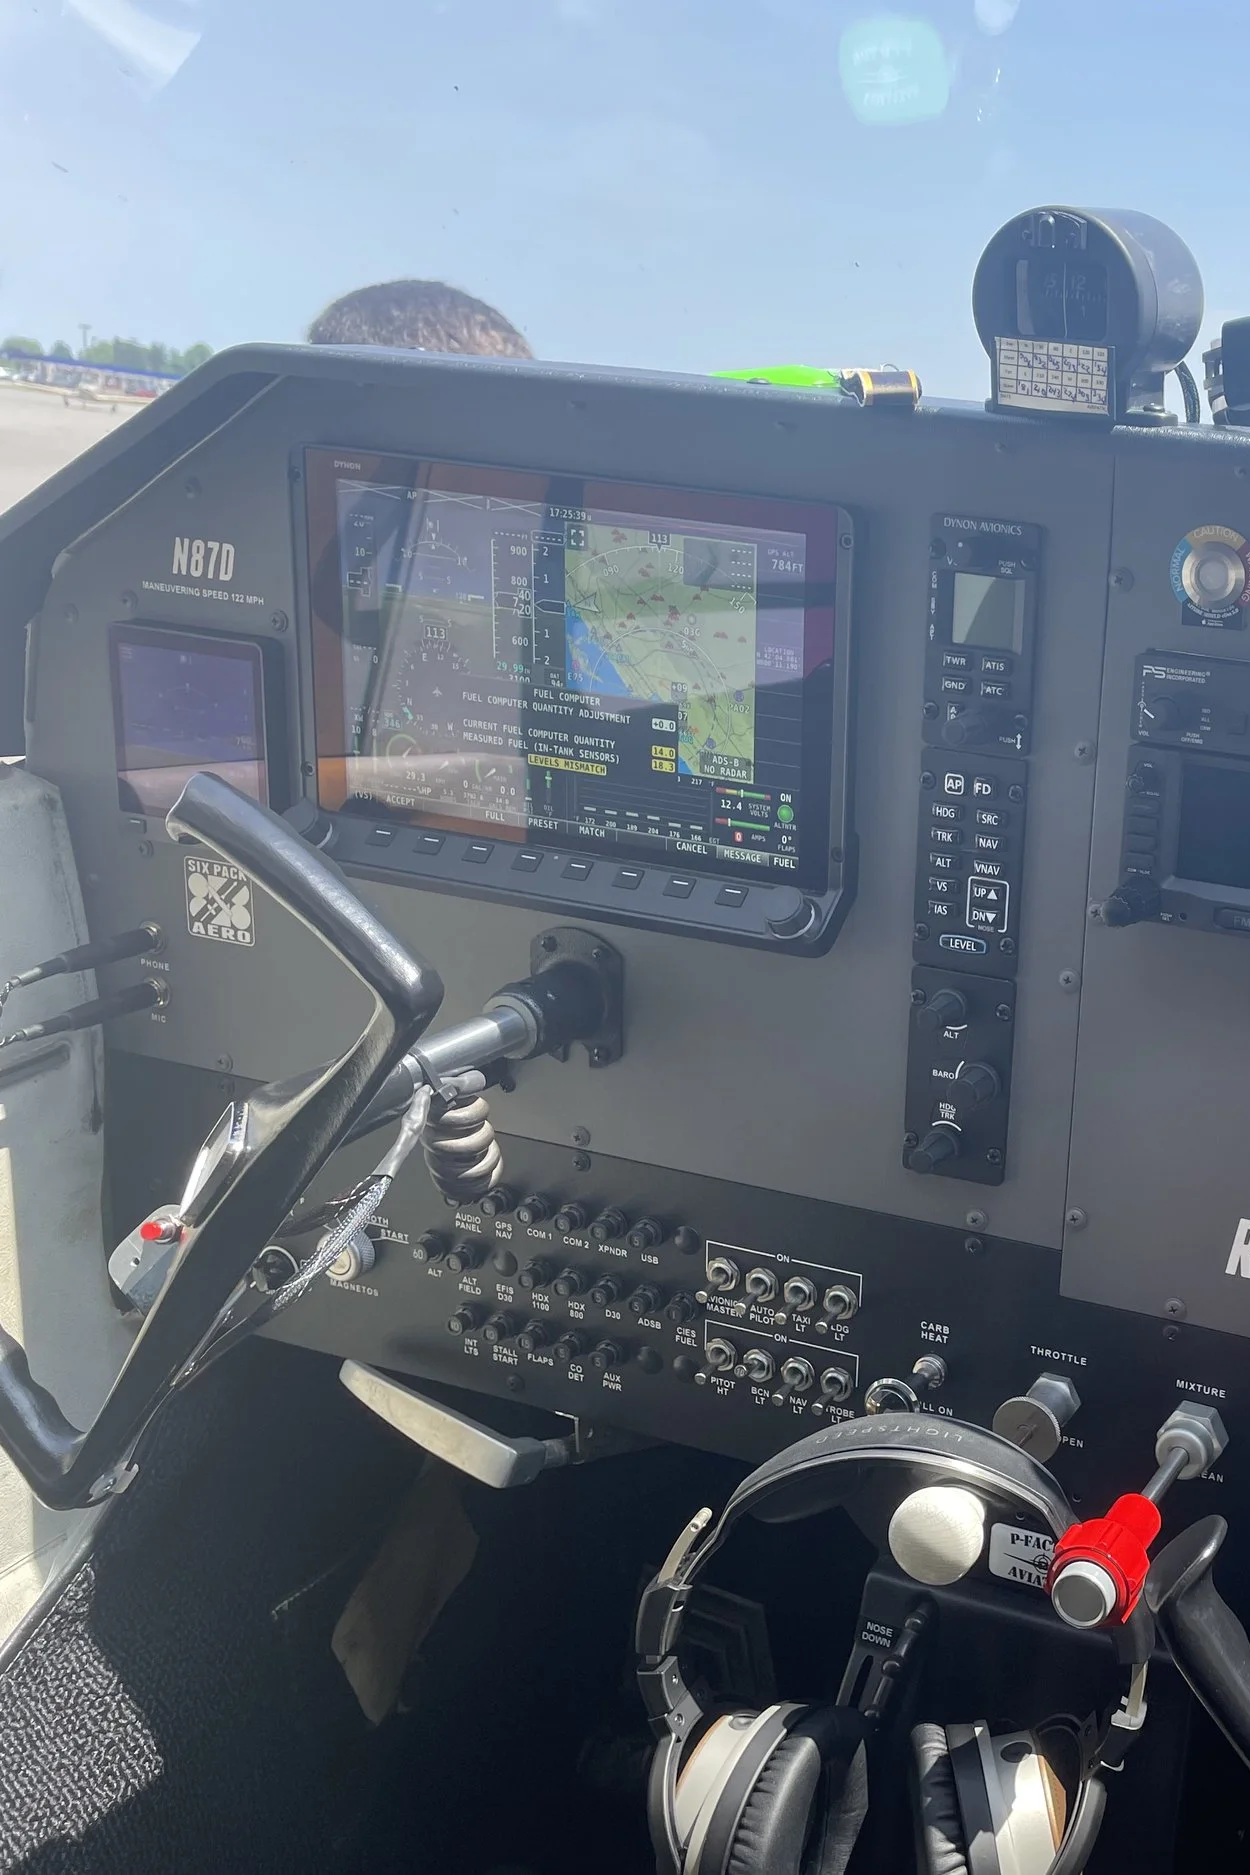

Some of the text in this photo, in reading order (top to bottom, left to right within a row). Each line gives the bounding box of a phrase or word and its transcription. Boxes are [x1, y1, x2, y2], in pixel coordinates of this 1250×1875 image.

[944, 518, 1022, 536] DYNON AVIONICS
[1192, 526, 1240, 542] CAUTION
[172, 537, 235, 581] N87D
[1173, 547, 1186, 592] NORMAL
[142, 581, 265, 605] MANEUVERING SPEED 122 MPH
[946, 656, 966, 666] TWR
[985, 661, 1005, 671] ATIS
[945, 681, 965, 690] GND
[985, 686, 1003, 696] ATC
[462, 692, 631, 724] FUEL COMPUTER QUANTITY ADJUSTMENT
[529, 754, 606, 775] LEVELS MISMATCH
[712, 756, 739, 767] ADS-B
[704, 765, 747, 778] NO RADAR
[947, 779, 962, 789] AP
[976, 783, 991, 795] FD
[936, 807, 955, 818] HDG
[981, 814, 998, 825] SRC
[937, 831, 952, 842] TRK
[979, 838, 998, 849] NAV
[935, 857, 951, 868] ALT
[188, 860, 247, 881] SIX PACK
[975, 863, 1000, 875] VNAV
[936, 881, 948, 892] VS
[974, 887, 987, 898] UP
[934, 904, 948, 915] IAS
[973, 911, 986, 922] DN
[192, 921, 251, 943] AERO
[950, 938, 977, 951] LEVEL
[141, 959, 170, 971] PHONE
[151, 1013, 166, 1023] MIC
[943, 1030, 959, 1039] ALT
[932, 1069, 955, 1080] BARO
[941, 1111, 955, 1120] TRK
[455, 1212, 481, 1225] AUDIO
[455, 1221, 482, 1233] PANEL
[495, 1221, 512, 1232] GPS
[380, 1229, 409, 1240] START
[495, 1229, 512, 1240] NAV
[526, 1228, 546, 1239] COM
[563, 1236, 589, 1249] COM 2
[598, 1244, 628, 1258] XPNDR
[641, 1254, 659, 1265] USB
[776, 1254, 790, 1263] ON
[427, 1268, 443, 1278] ALT
[462, 1276, 477, 1286] ALT
[330, 1279, 379, 1297] MAGNETOS
[458, 1283, 482, 1295] FIELD
[496, 1284, 514, 1295] EFIS
[497, 1292, 513, 1302] D30
[532, 1292, 549, 1303] HDX
[532, 1300, 549, 1312] 1100
[568, 1300, 585, 1311] HDX
[750, 1305, 775, 1317] AUTO
[569, 1309, 584, 1320] 800
[605, 1309, 621, 1320] D30
[749, 1313, 775, 1326] PILOT
[791, 1313, 811, 1325] TAXI
[637, 1317, 661, 1330] ADSB
[795, 1322, 806, 1332] LT
[920, 1320, 950, 1335] CARB
[676, 1326, 696, 1338] CIES
[921, 1331, 949, 1344] HEAT
[464, 1338, 478, 1348] INT
[675, 1334, 697, 1347] FUEL
[774, 1333, 788, 1343] ON
[464, 1346, 479, 1356] LTS
[493, 1345, 518, 1358] STALL
[1030, 1345, 1088, 1366] THROTTLE
[492, 1353, 519, 1365] START
[527, 1354, 554, 1367] FLAPS
[570, 1363, 583, 1373] CO
[568, 1371, 584, 1382] DET
[603, 1372, 621, 1383] AUX
[602, 1381, 622, 1392] PWR
[710, 1377, 736, 1389] PITOT
[717, 1386, 728, 1395] HT
[751, 1387, 770, 1398] BCN
[1176, 1379, 1226, 1399] MIXTURE
[755, 1395, 765, 1405] LT
[789, 1396, 807, 1407] NAV
[792, 1404, 803, 1414] LT
[866, 1621, 893, 1637] NOSE
[862, 1631, 891, 1648] DOWN
